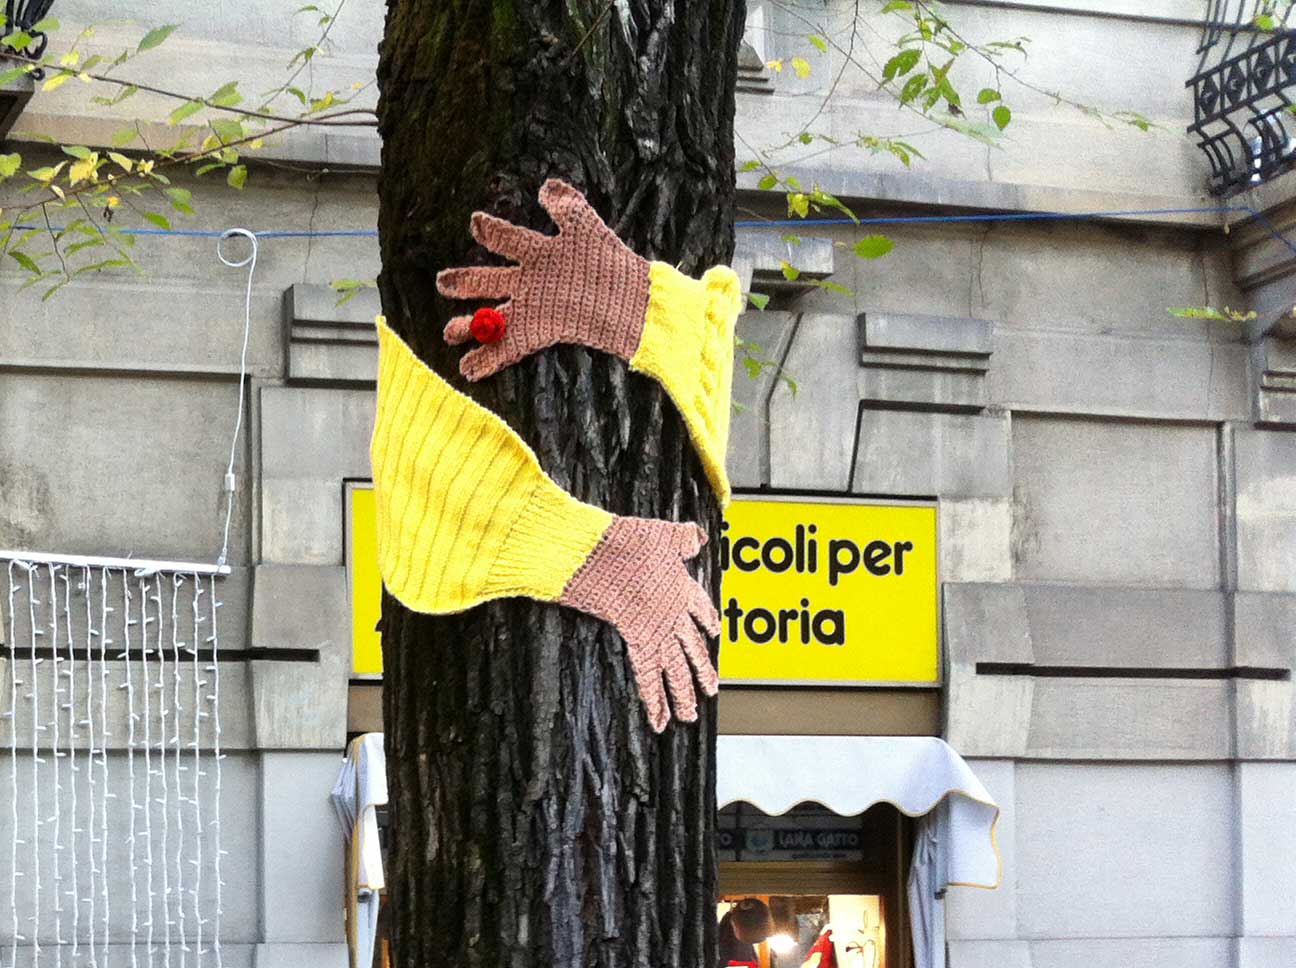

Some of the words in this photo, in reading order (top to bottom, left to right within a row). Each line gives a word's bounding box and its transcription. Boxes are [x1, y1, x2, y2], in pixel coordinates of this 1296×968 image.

[720, 522, 816, 573] icoli
[829, 540, 912, 585] per
[724, 599, 844, 645] toria
